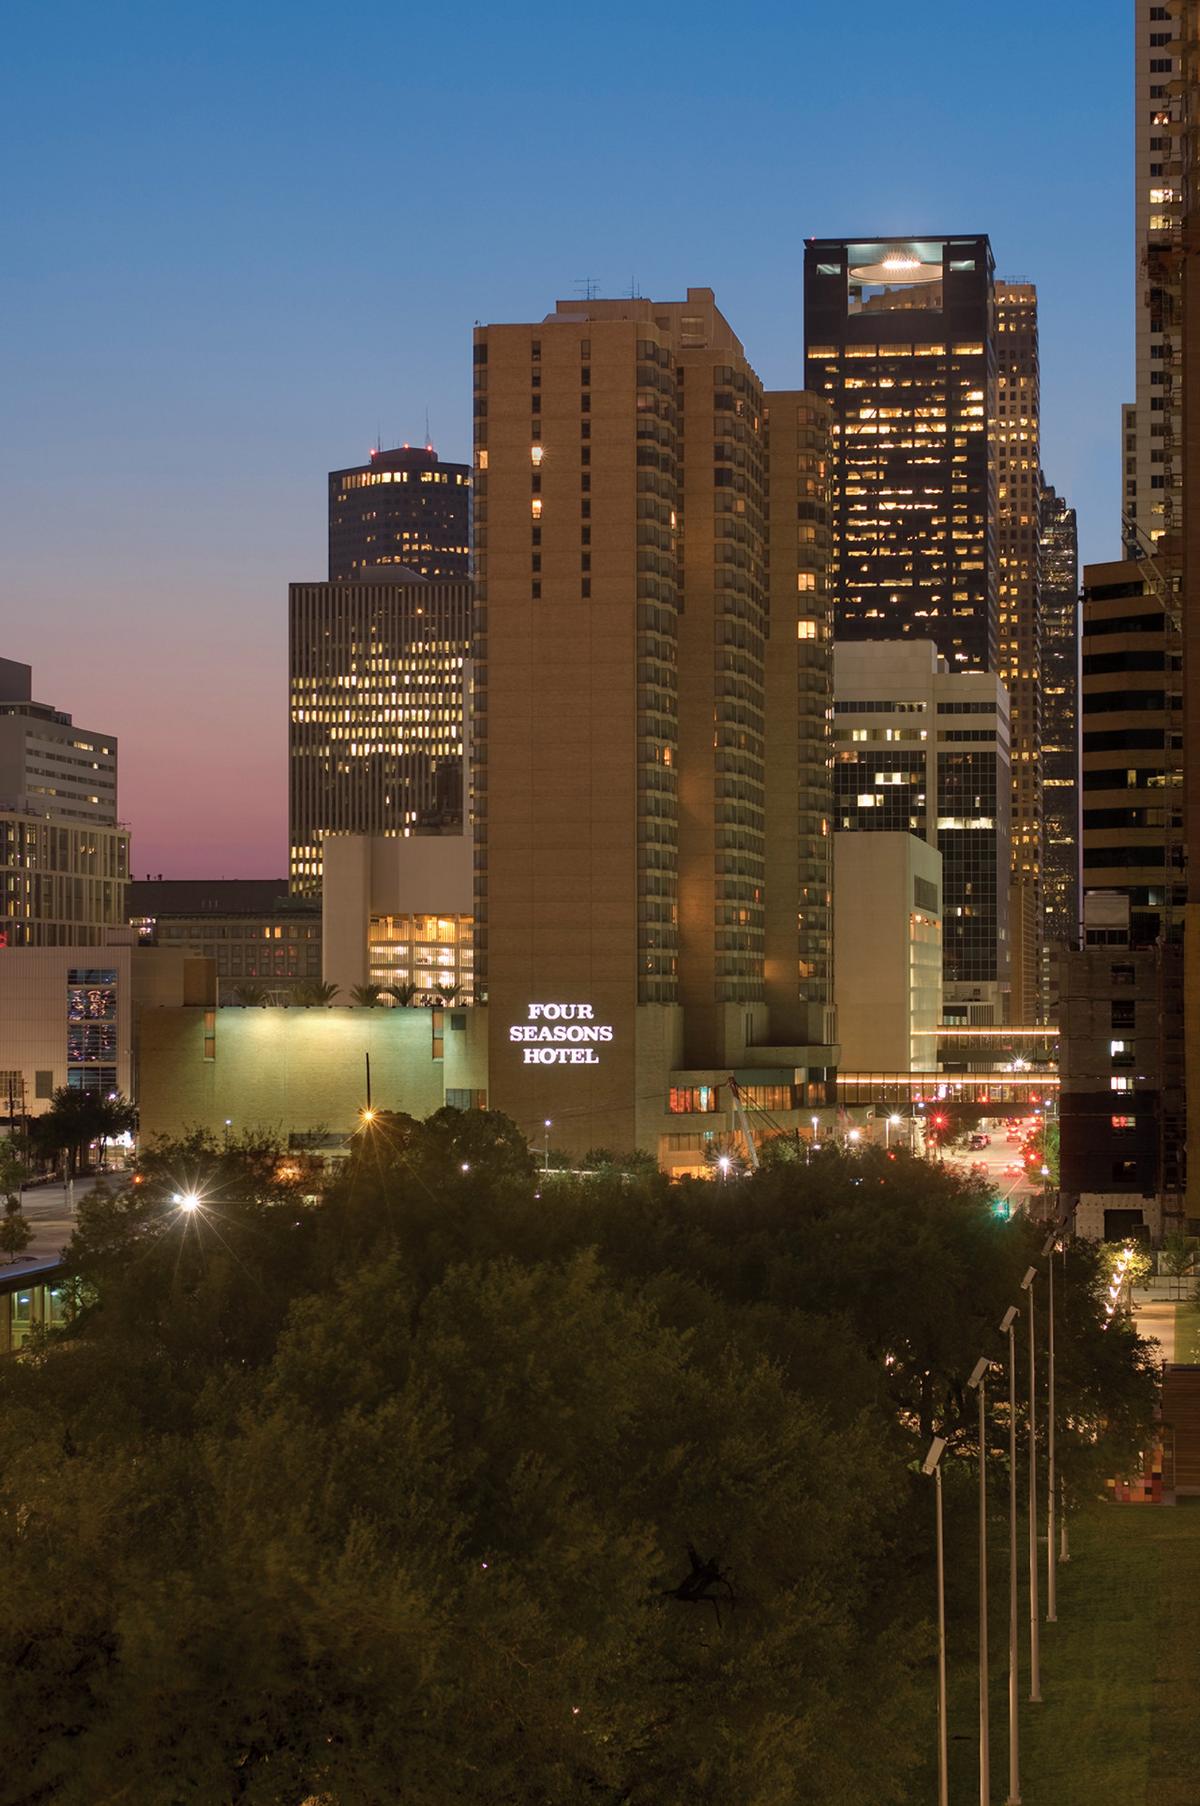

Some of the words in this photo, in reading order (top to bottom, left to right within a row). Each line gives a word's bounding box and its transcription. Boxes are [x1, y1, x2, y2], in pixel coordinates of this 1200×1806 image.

[528, 1003, 594, 1020] FOUR
[509, 1025, 613, 1042] SEASONS
[523, 1048, 600, 1064] HOTEL
